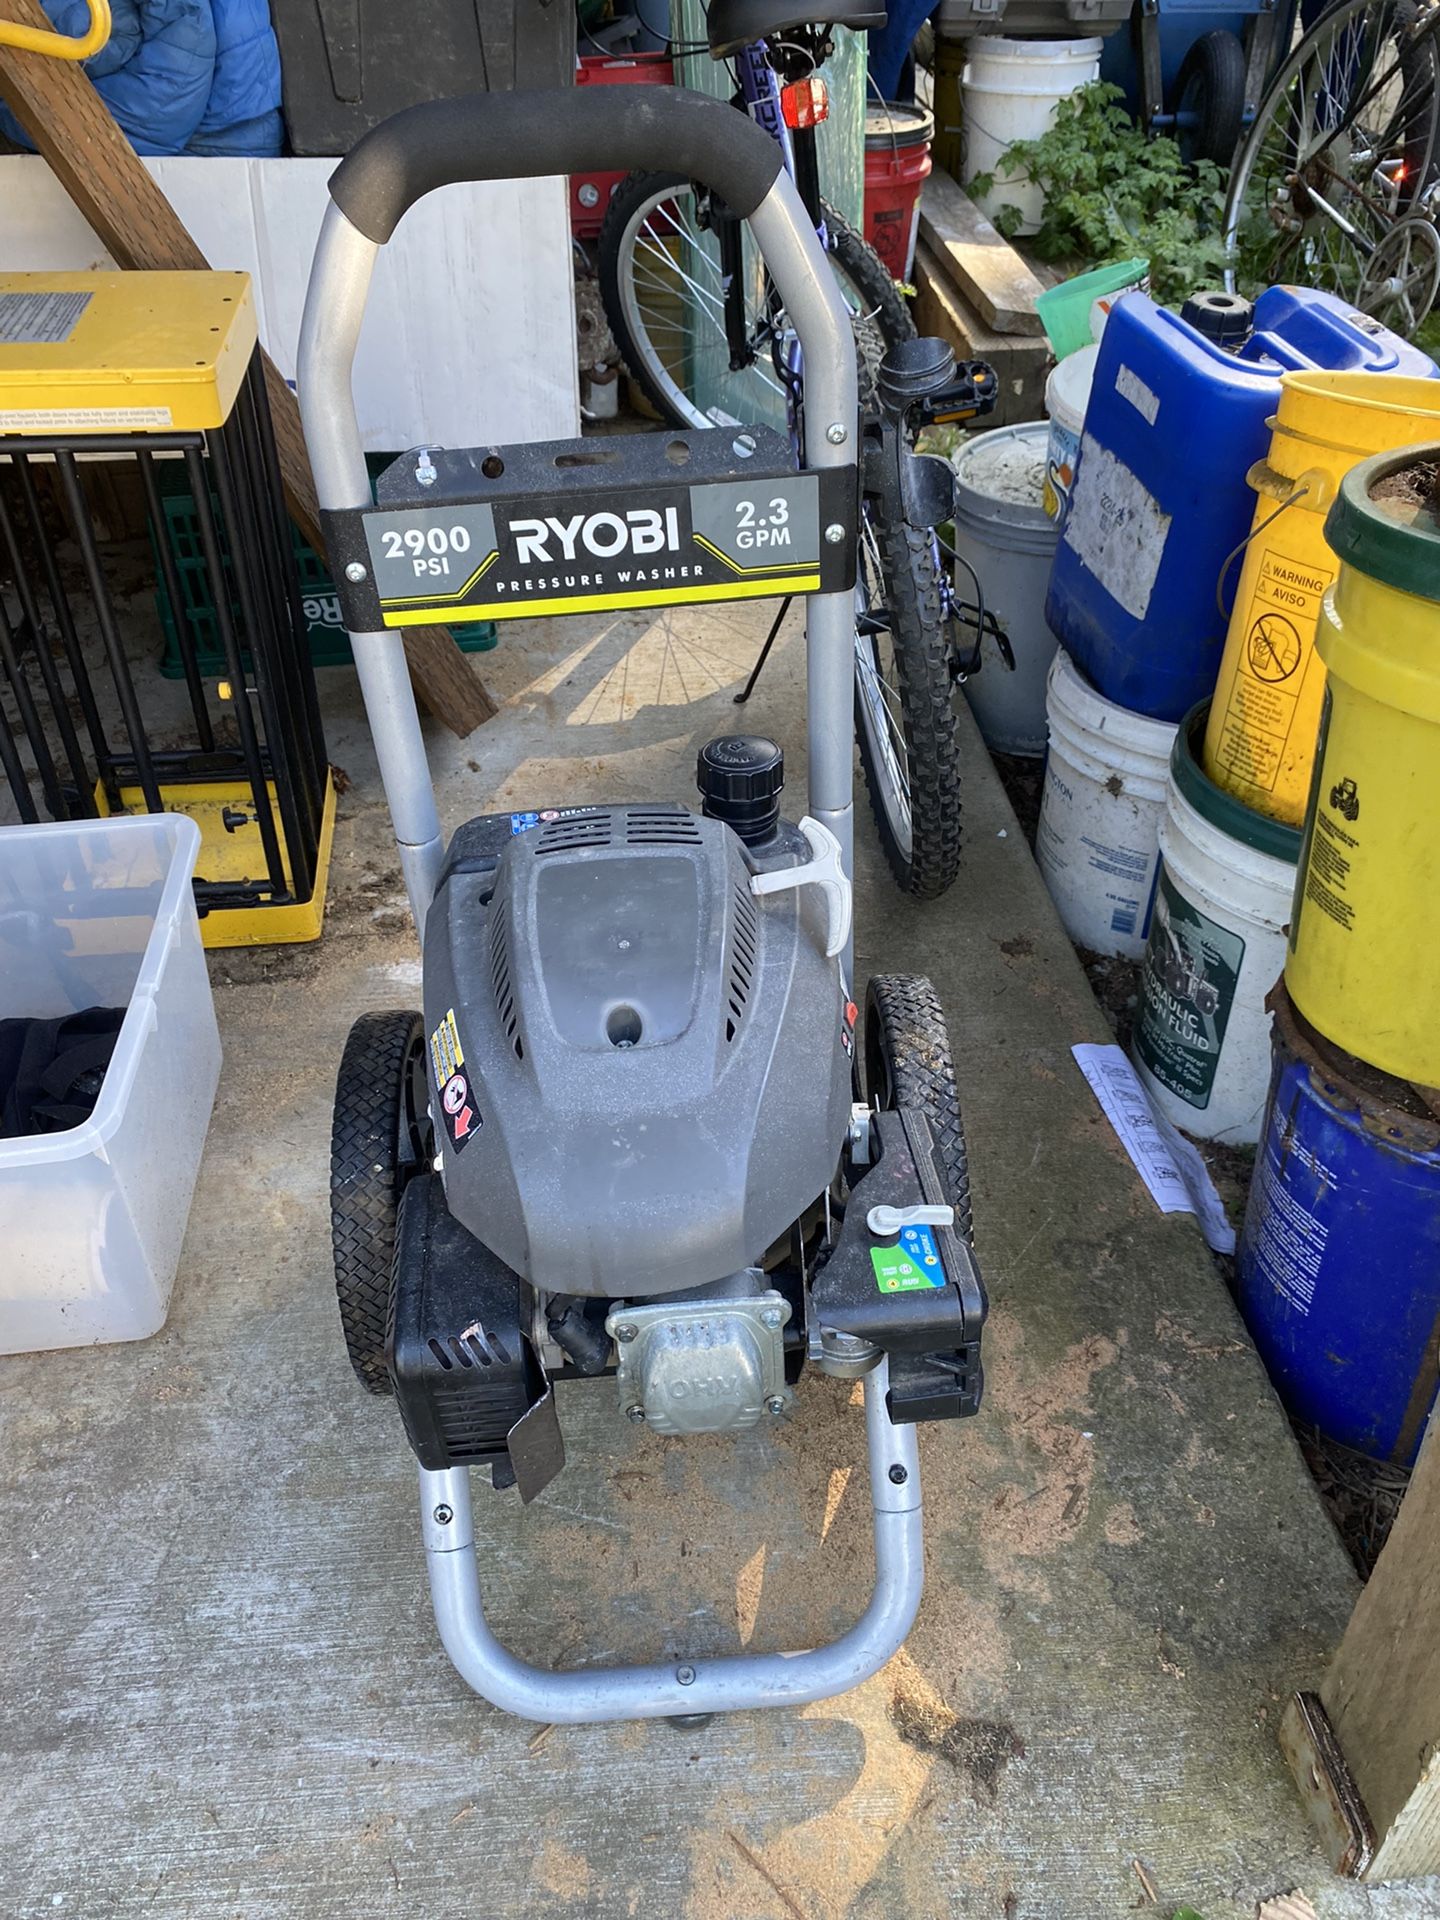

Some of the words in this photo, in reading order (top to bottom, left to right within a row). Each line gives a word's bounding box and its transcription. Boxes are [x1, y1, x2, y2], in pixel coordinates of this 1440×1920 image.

[735, 498, 789, 527] 2.3
[381, 526, 470, 559] 2900
[508, 507, 680, 564] RYOBI
[736, 527, 791, 549] GPM
[413, 557, 450, 577] PSI
[496, 574, 604, 593] PRESSURE
[618, 565, 704, 584] WASHER
[1273, 565, 1323, 592] WARNING
[1272, 588, 1306, 607] AVISO
[1168, 1015, 1210, 1050] FLUID
